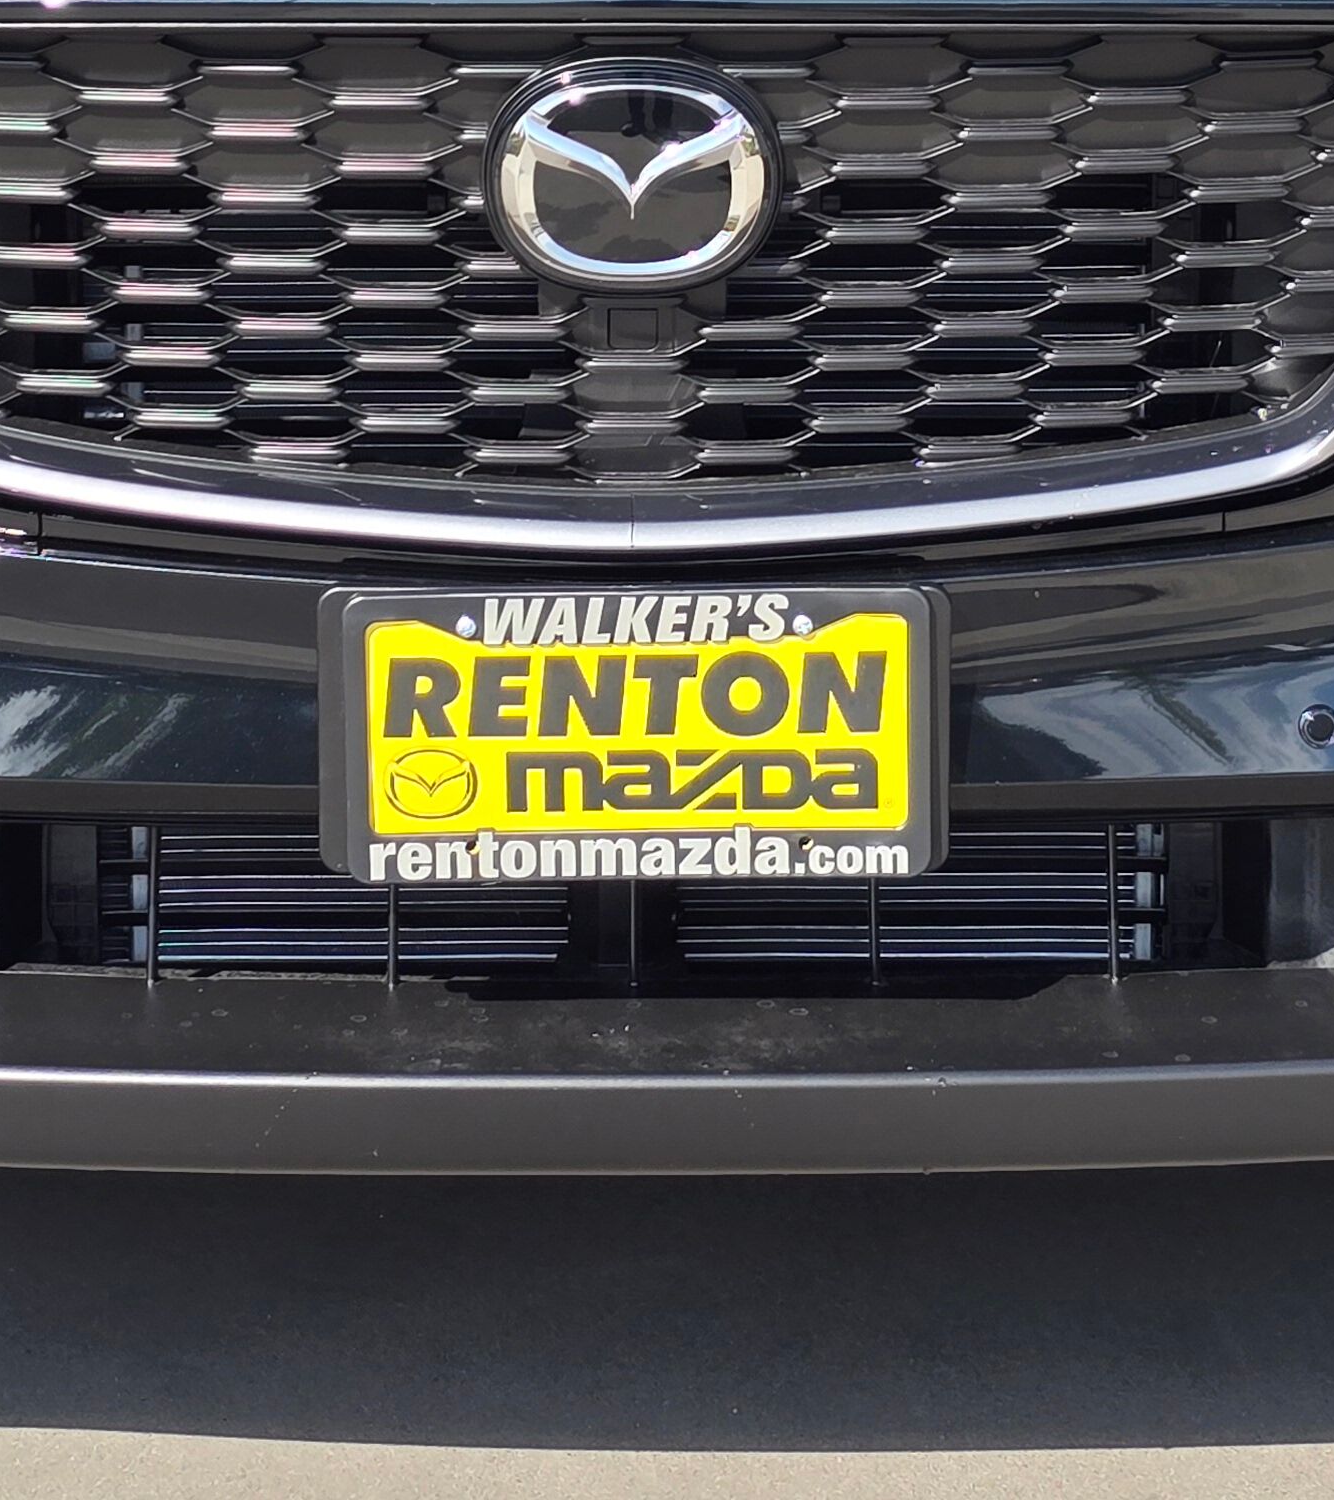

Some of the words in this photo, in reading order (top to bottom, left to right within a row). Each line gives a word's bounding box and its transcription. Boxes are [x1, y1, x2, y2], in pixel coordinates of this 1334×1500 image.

[482, 594, 789, 645] WALKER'S
[383, 651, 887, 738] RENTON
[369, 826, 909, 881] rentonmazda.com
